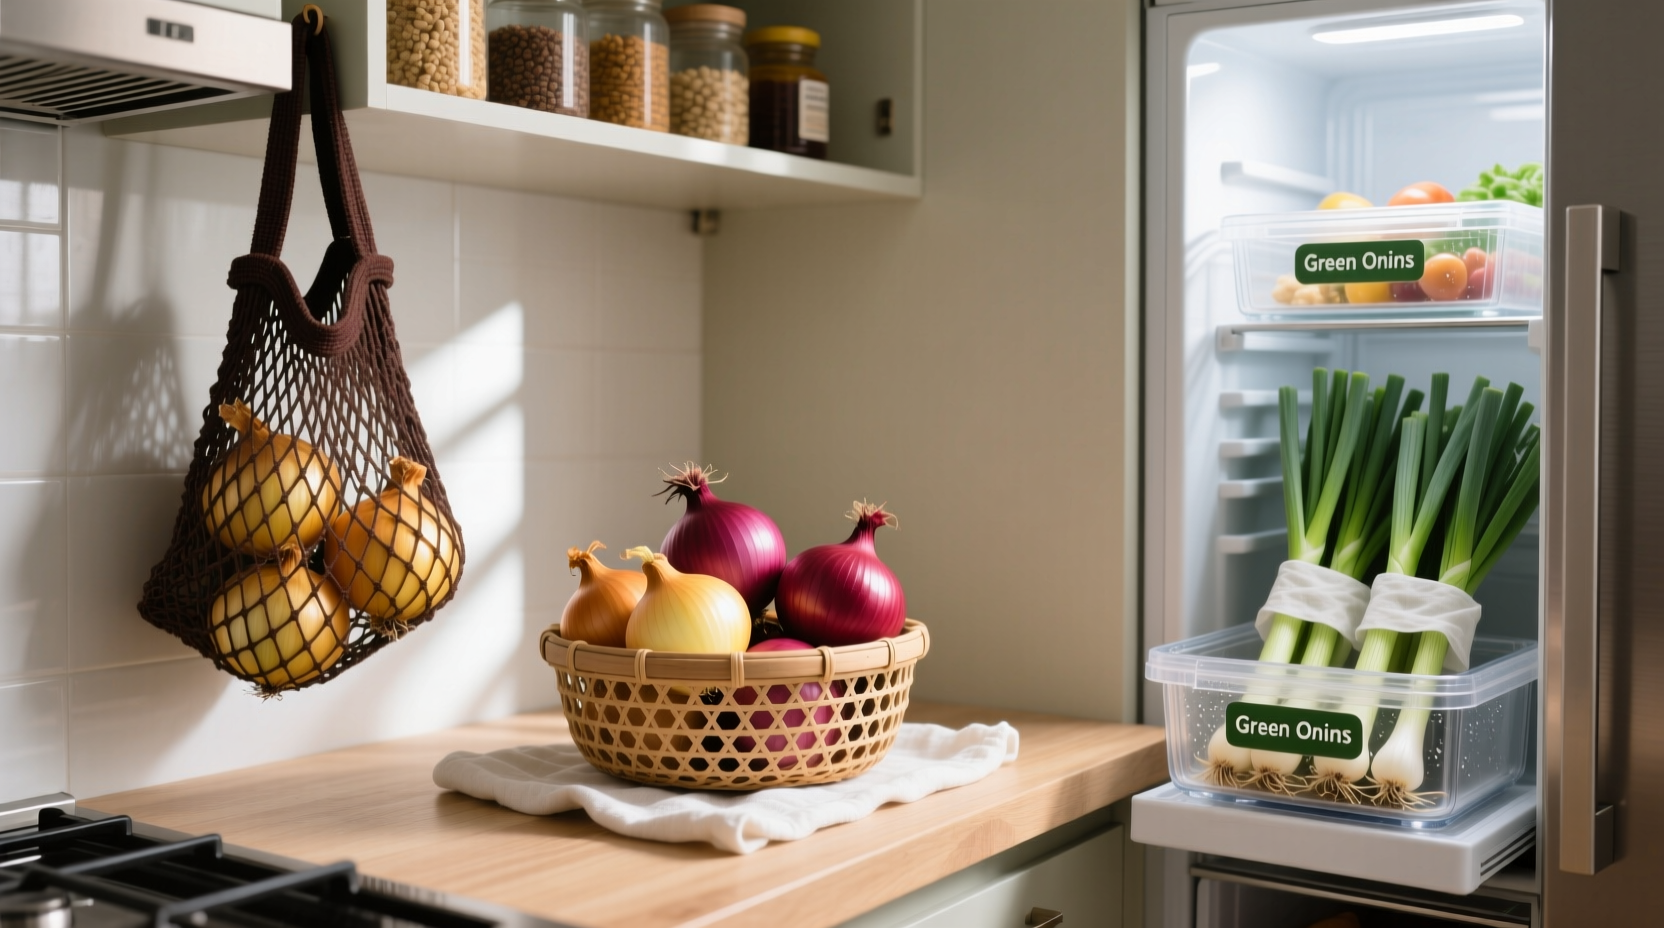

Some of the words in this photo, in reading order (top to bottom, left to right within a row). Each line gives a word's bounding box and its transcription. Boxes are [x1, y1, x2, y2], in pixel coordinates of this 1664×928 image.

[1304, 253, 1357, 272] Green
[1362, 250, 1415, 270] Onins
[1235, 714, 1290, 738] Green
[1296, 721, 1352, 745] Onins
